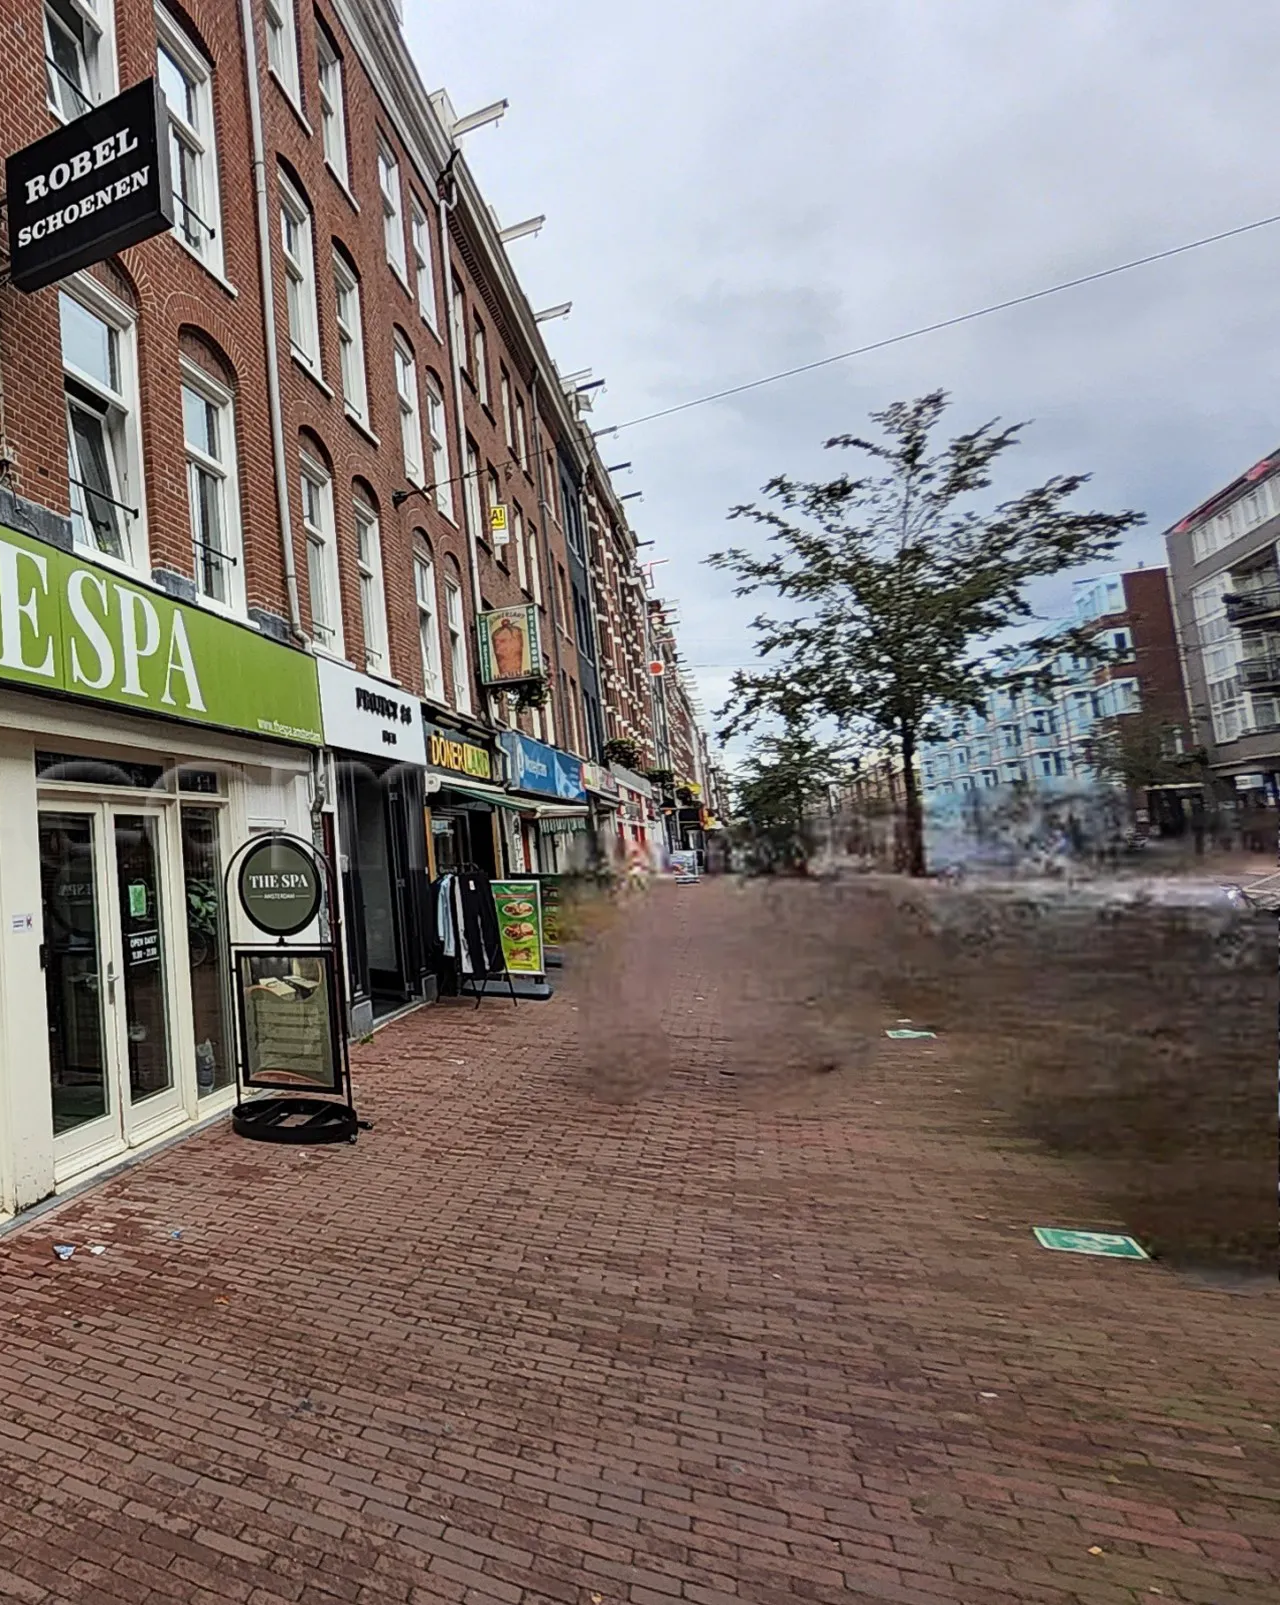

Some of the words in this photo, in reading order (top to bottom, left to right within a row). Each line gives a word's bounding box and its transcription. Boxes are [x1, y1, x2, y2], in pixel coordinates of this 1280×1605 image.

[25, 127, 139, 205] ROBEL
[17, 165, 151, 248] SCHOENEN
[66, 569, 208, 713] SPA
[249, 874, 279, 889] THE
[281, 873, 309, 888] SPA
[264, 892, 296, 900] AMSTERDAM
[130, 938, 144, 948] OPEN
[144, 935, 158, 945] DAILY
